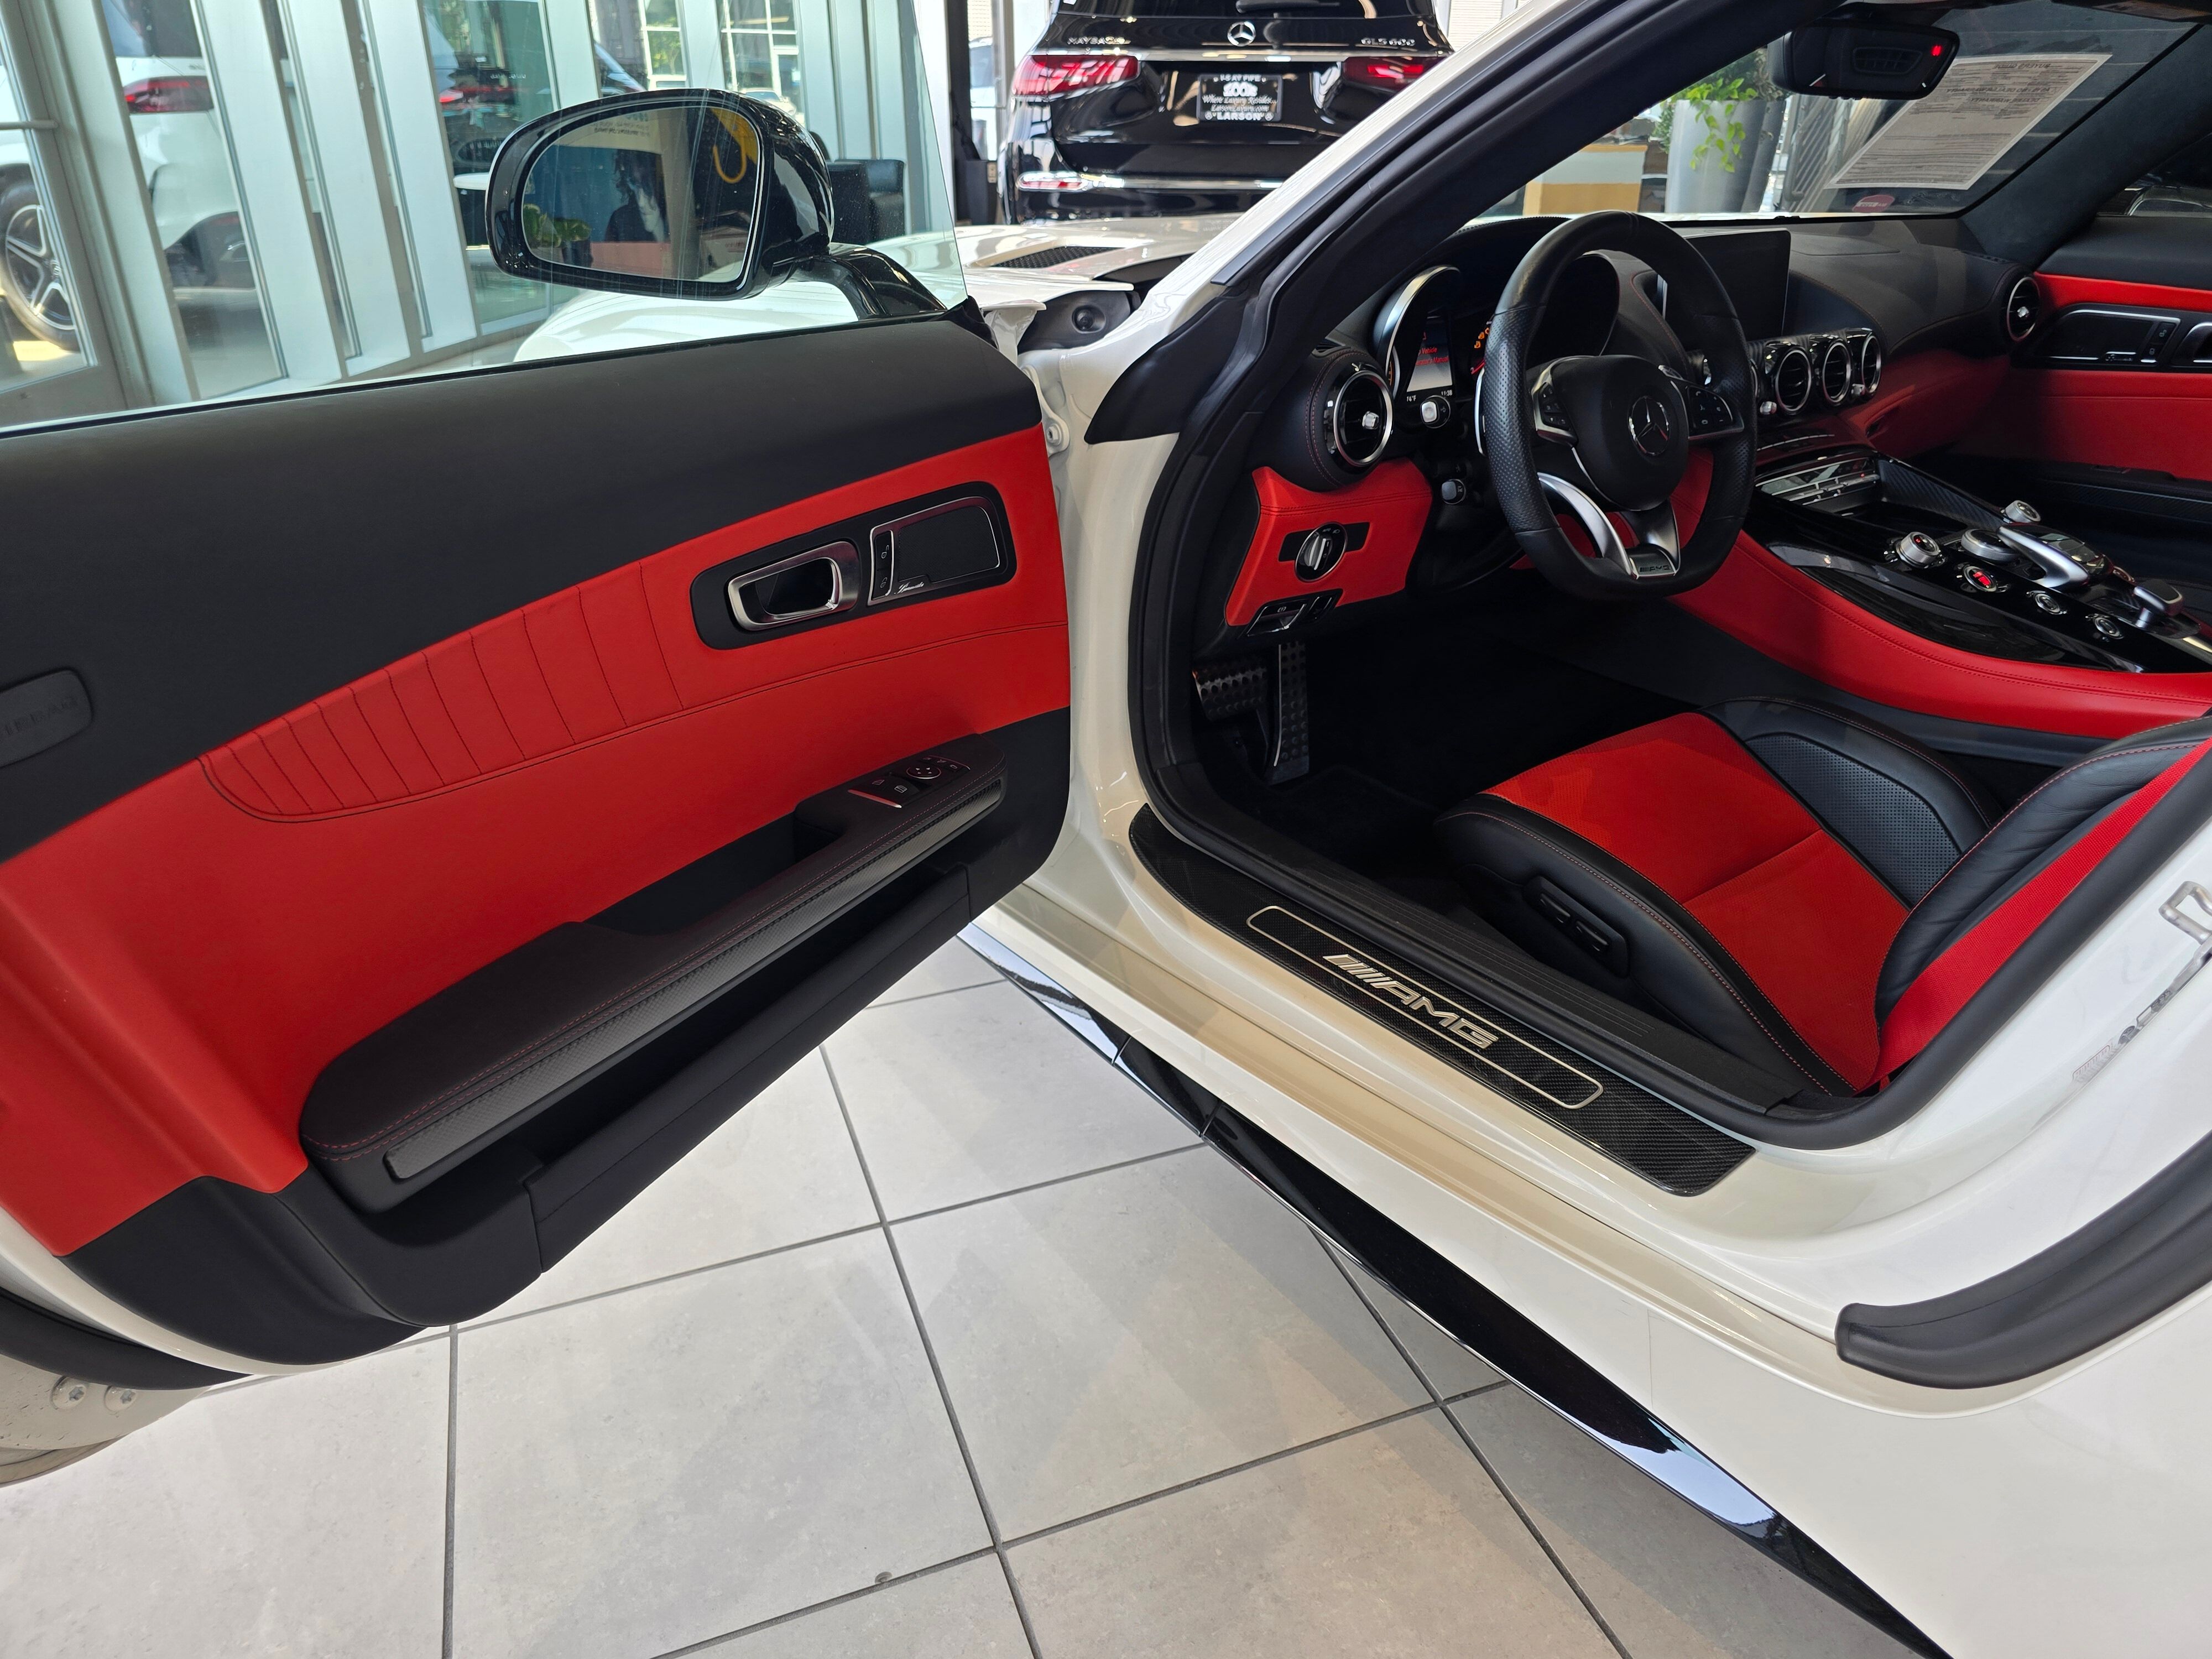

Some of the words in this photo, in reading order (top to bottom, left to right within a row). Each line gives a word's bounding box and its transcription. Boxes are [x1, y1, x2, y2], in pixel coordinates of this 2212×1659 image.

[1361, 37, 1387, 45] GLS
[1389, 38, 1415, 46] 600
[1217, 111, 1262, 121] LARSON
